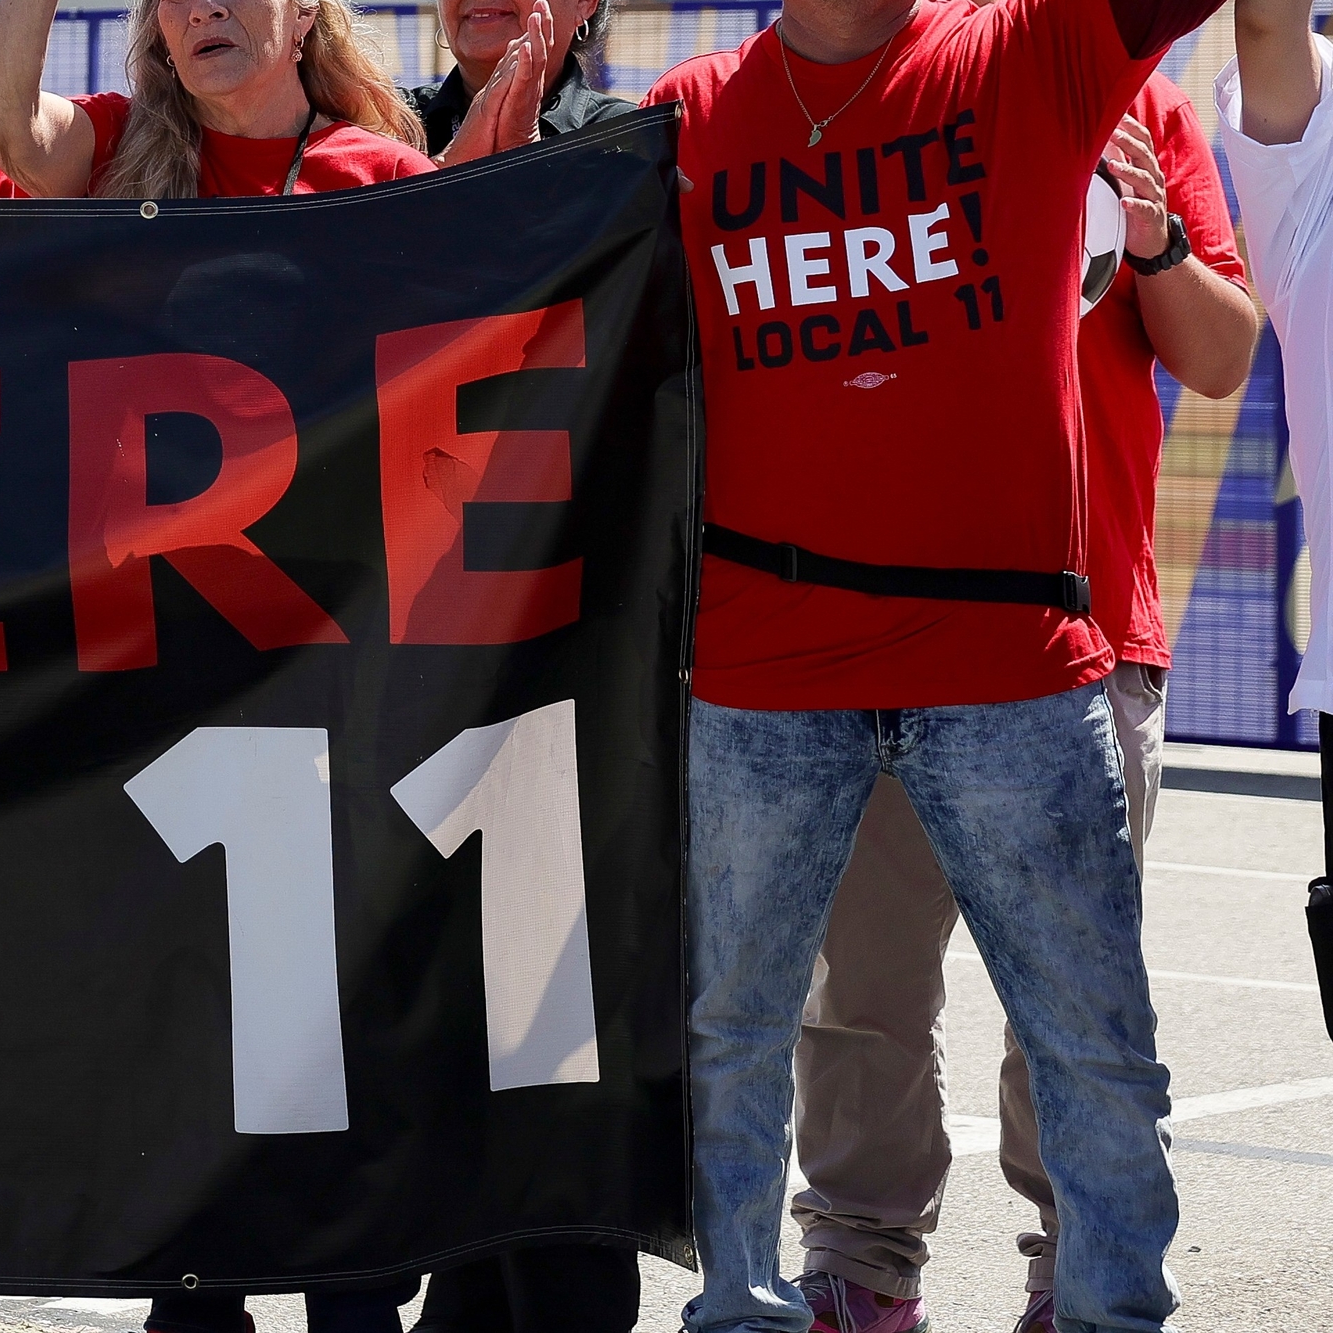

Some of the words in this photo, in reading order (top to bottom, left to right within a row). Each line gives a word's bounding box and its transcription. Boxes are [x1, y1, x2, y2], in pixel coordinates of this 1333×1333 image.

[711, 108, 987, 232] UNITE
[710, 190, 990, 316] HERE!
[733, 300, 930, 372] LOCAL
[953, 275, 1004, 331] 11
[122, 698, 601, 1134] 11
